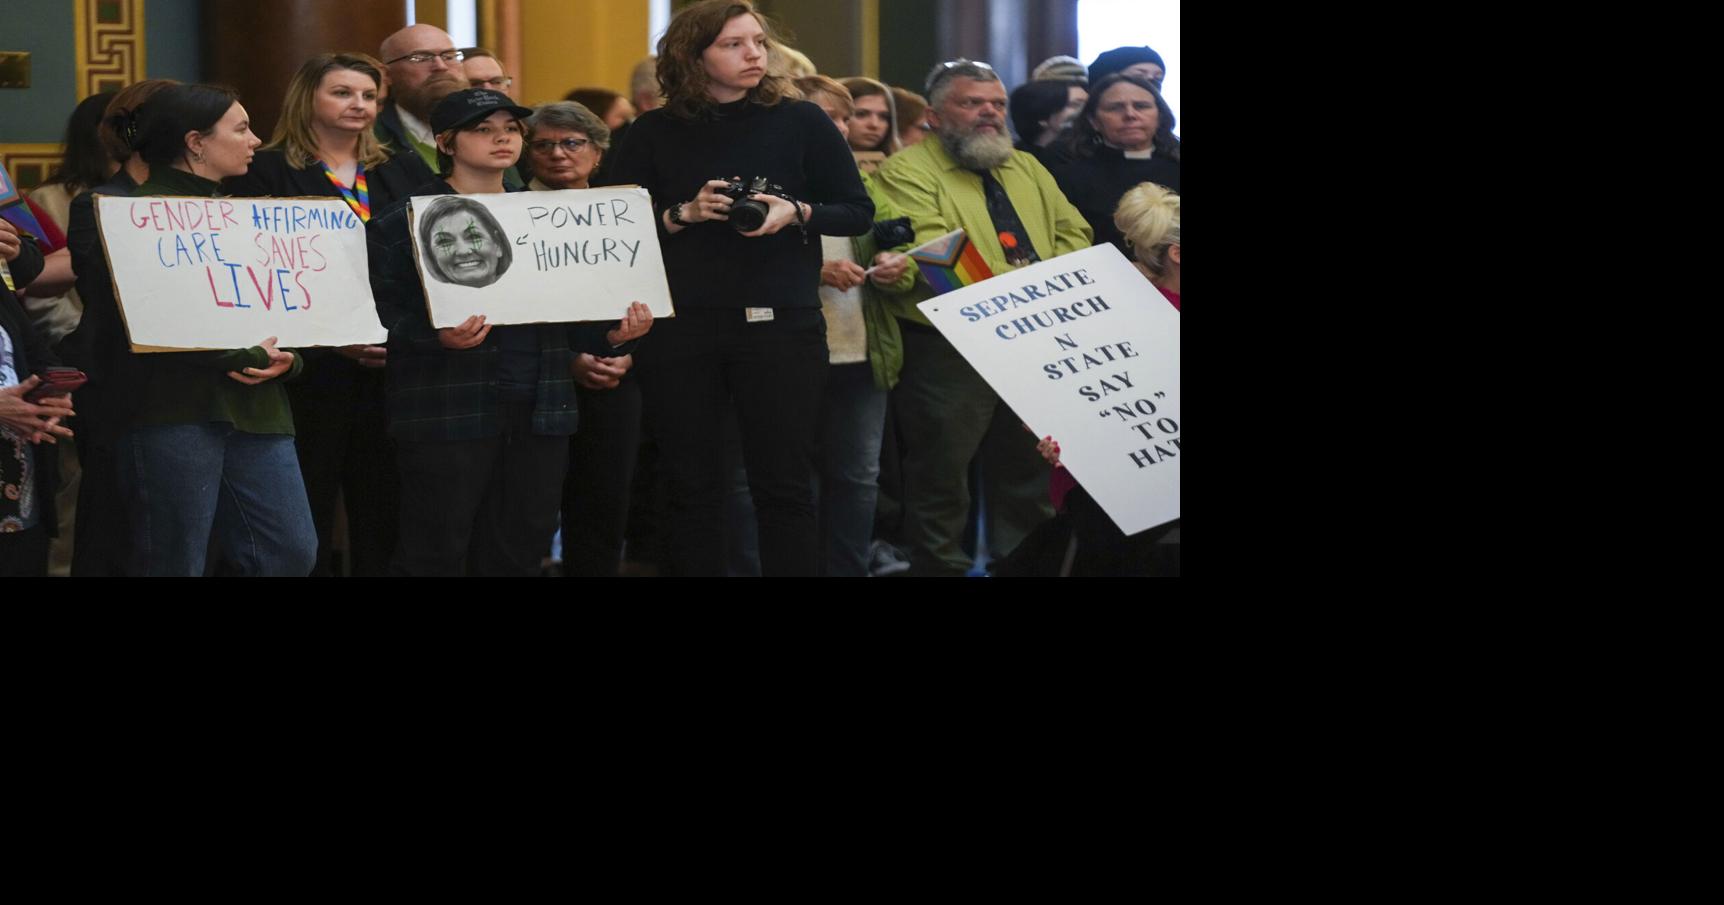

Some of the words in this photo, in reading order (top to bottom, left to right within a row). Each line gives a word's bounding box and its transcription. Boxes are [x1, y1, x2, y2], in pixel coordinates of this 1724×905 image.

[130, 201, 239, 231] GENDER
[252, 204, 357, 234] AFFIRMING
[527, 199, 635, 228] POWER
[158, 233, 225, 268] CARE
[254, 233, 327, 272] SAVES
[532, 239, 641, 272] HUNGRY
[207, 263, 312, 311] LIVES
[959, 268, 1095, 323] SEPARATE
[995, 295, 1111, 341] CHURCH
[1054, 333, 1079, 352] N
[1043, 341, 1139, 381] STATE
[1078, 371, 1135, 402] SAY
[1131, 417, 1179, 441] TO
